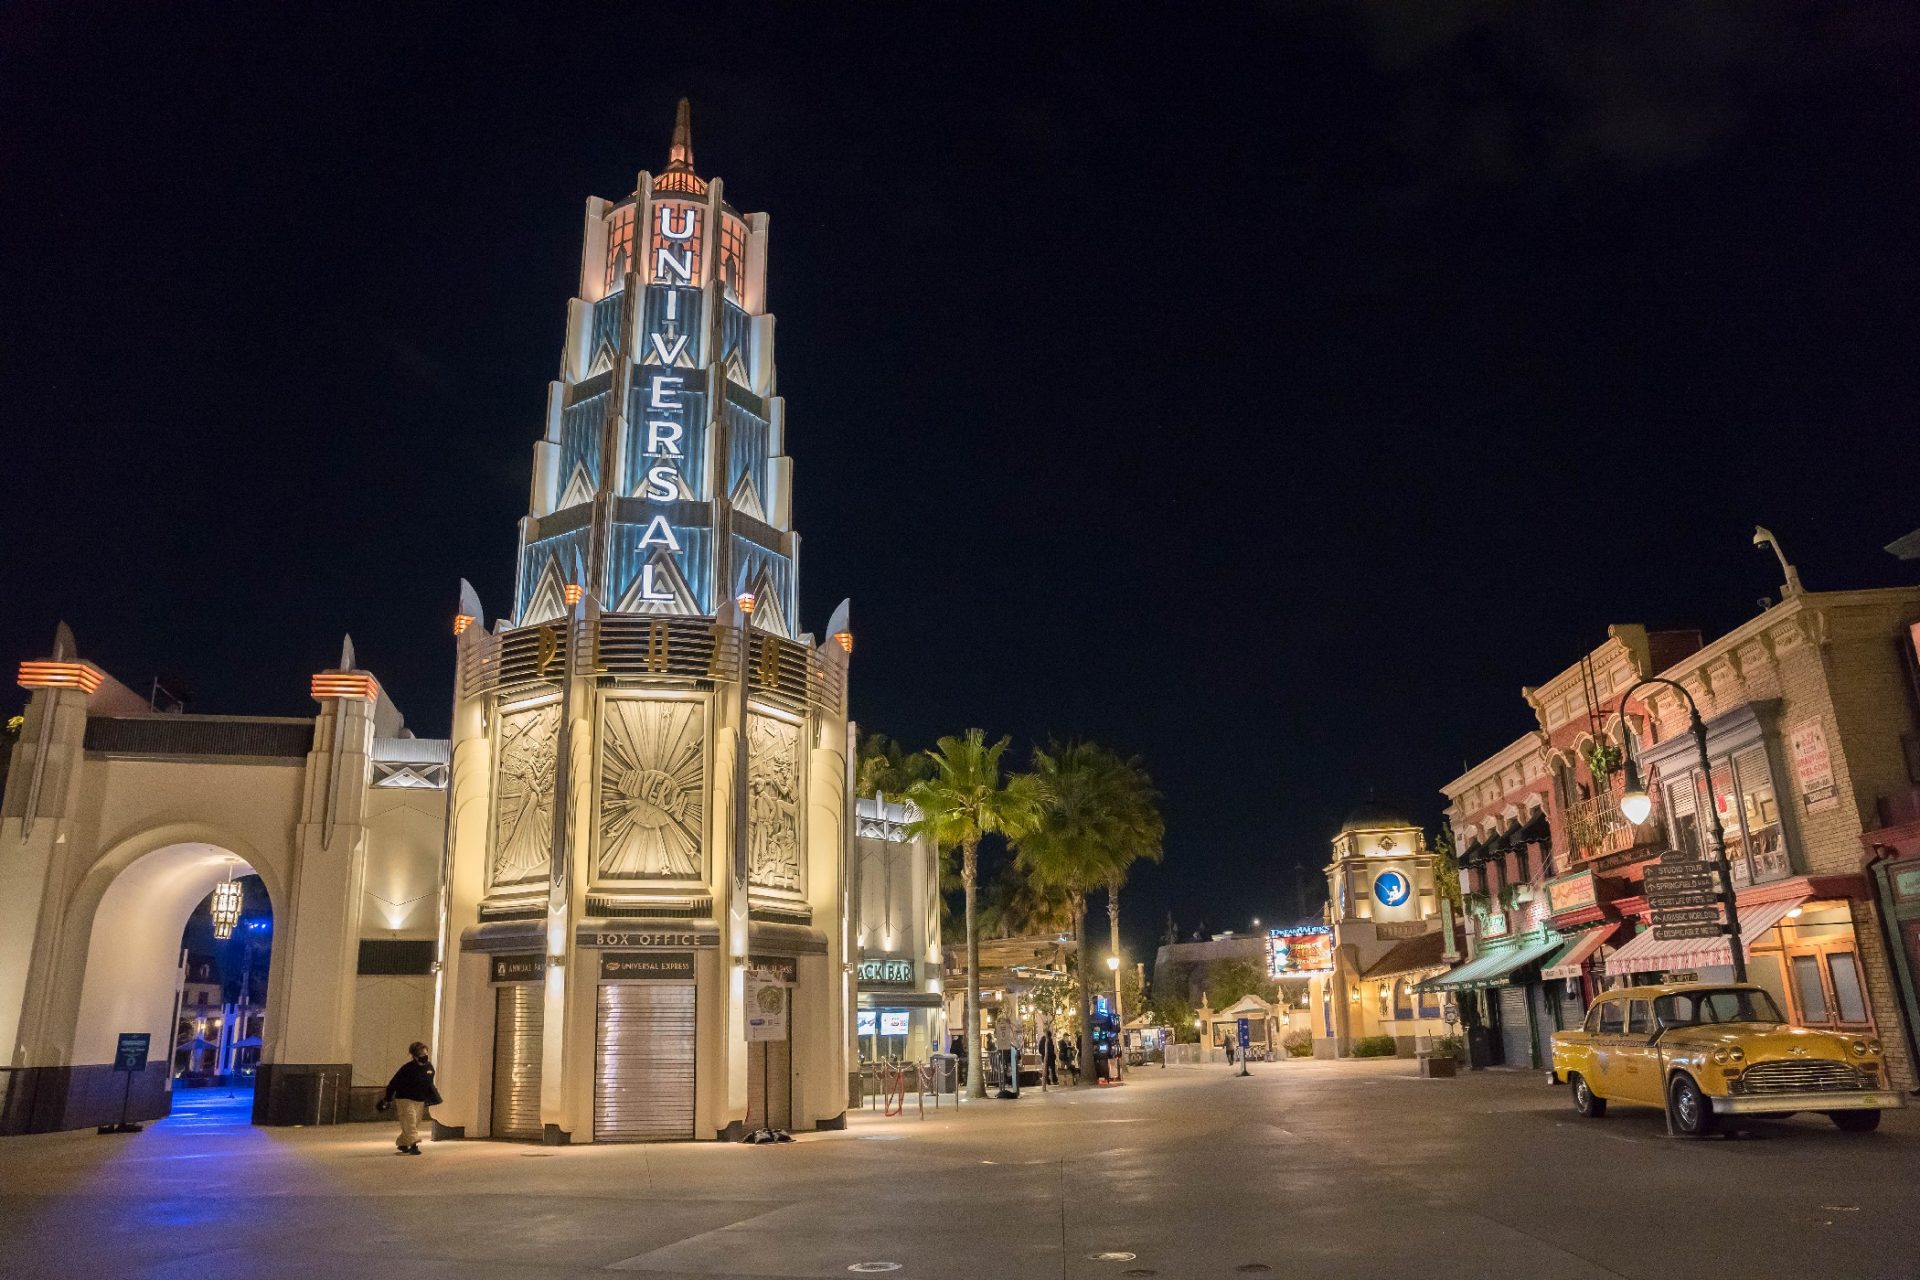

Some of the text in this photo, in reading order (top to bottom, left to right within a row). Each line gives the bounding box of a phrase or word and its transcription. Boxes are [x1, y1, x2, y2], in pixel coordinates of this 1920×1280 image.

[638, 206, 696, 602] UNIVERSAL
[1800, 761, 1829, 778] NELSON
[1659, 864, 1703, 875] STUDIO TOUR
[1656, 880, 1697, 890] SPRINGFIELD
[1662, 913, 1688, 921] JURASSIC
[1689, 911, 1709, 920] WORLD
[1663, 928, 1700, 937] DESPICABLE
[596, 934, 700, 945] BOX OFFICE
[508, 964, 532, 973] ANNUAL
[621, 962, 659, 970] UNIVERSAL
[661, 962, 689, 970] EXPRESS
[887, 965, 911, 981] BAR
